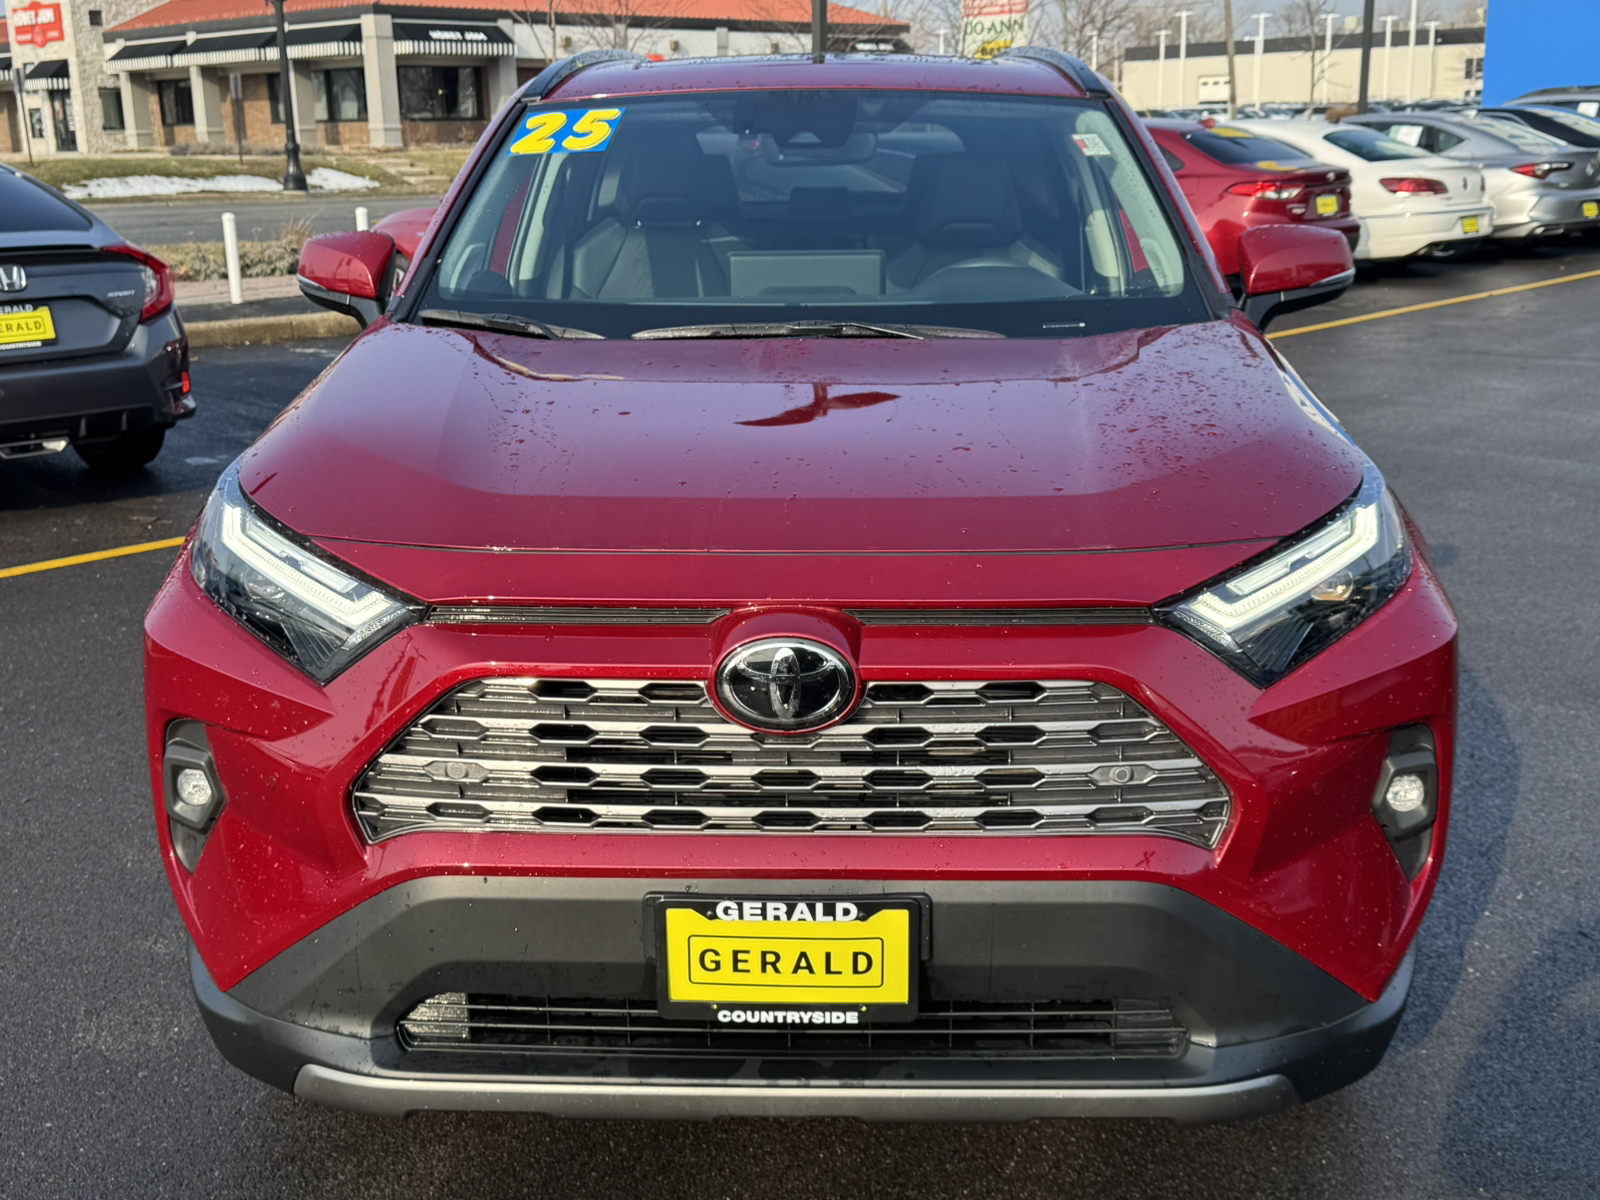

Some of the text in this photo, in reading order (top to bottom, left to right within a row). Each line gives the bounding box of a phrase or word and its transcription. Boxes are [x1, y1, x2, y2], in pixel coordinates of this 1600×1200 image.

[510, 109, 621, 154] 25
[0, 303, 34, 315] ERALD
[0, 320, 42, 333] ERALD
[715, 900, 859, 922] GERALD
[698, 948, 874, 976] GERALD
[717, 1010, 859, 1024] COUNTRYSIDE
